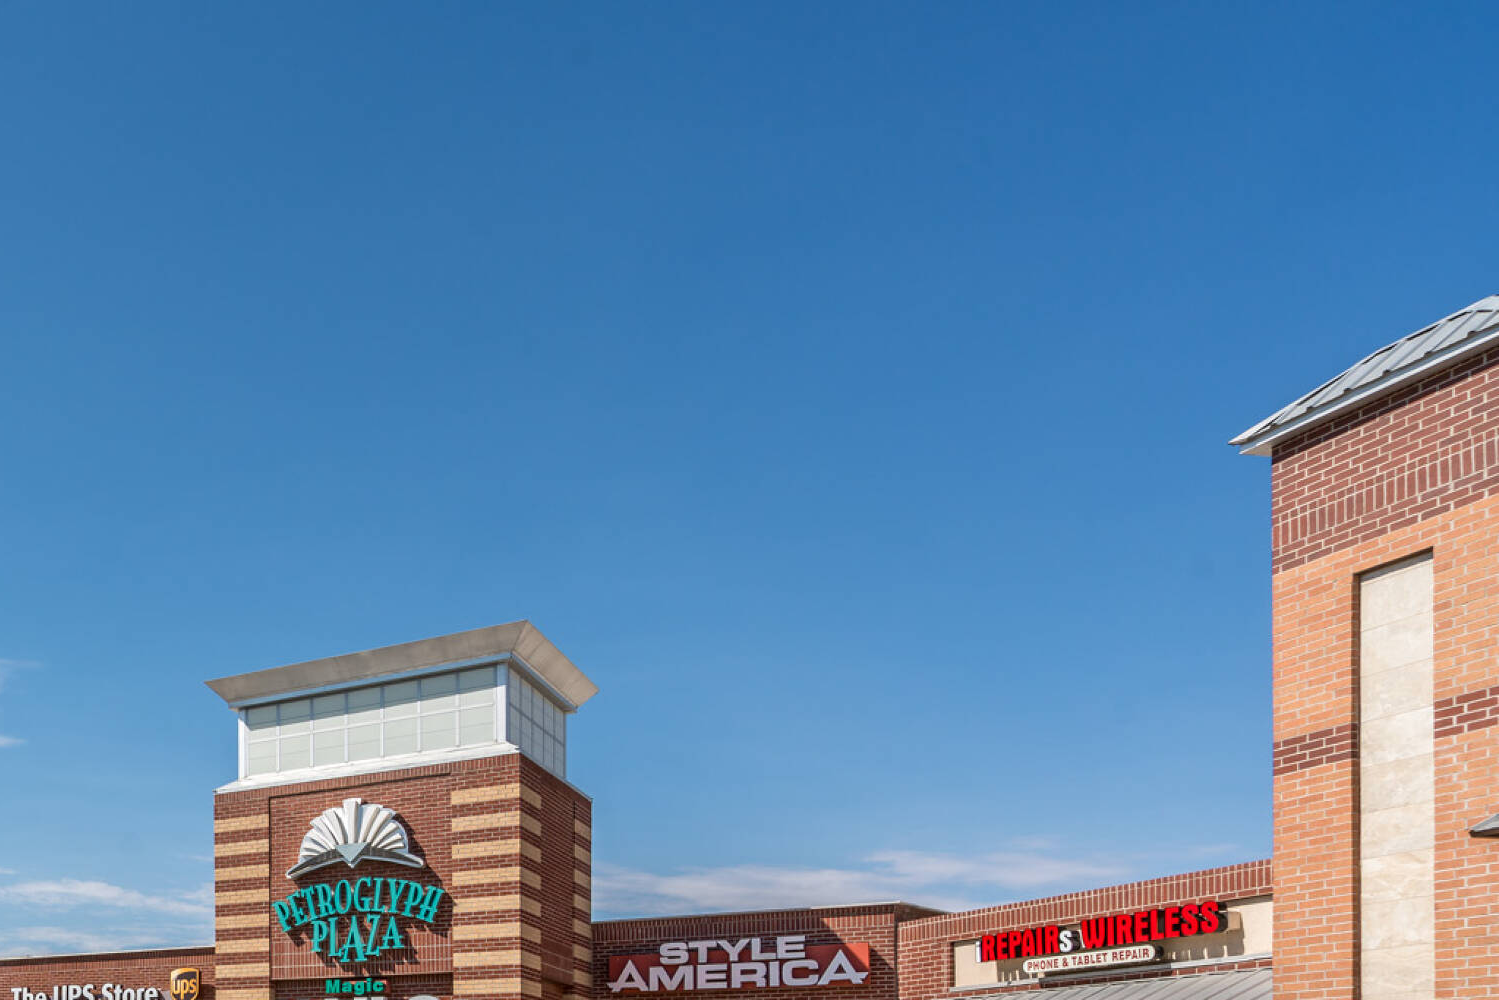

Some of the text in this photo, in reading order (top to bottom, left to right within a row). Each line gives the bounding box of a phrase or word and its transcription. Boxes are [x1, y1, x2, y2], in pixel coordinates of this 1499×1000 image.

[272, 876, 445, 932] PETROGLYPH
[311, 913, 405, 962] PLAZA
[1080, 901, 1220, 949] WIRELESS
[659, 935, 806, 965] STYLE
[1026, 947, 1150, 971] PHONE & TABLET REPAIR
[173, 978, 197, 1000] ups
[325, 977, 385, 996] Magic
[606, 949, 869, 993] AMERICA
